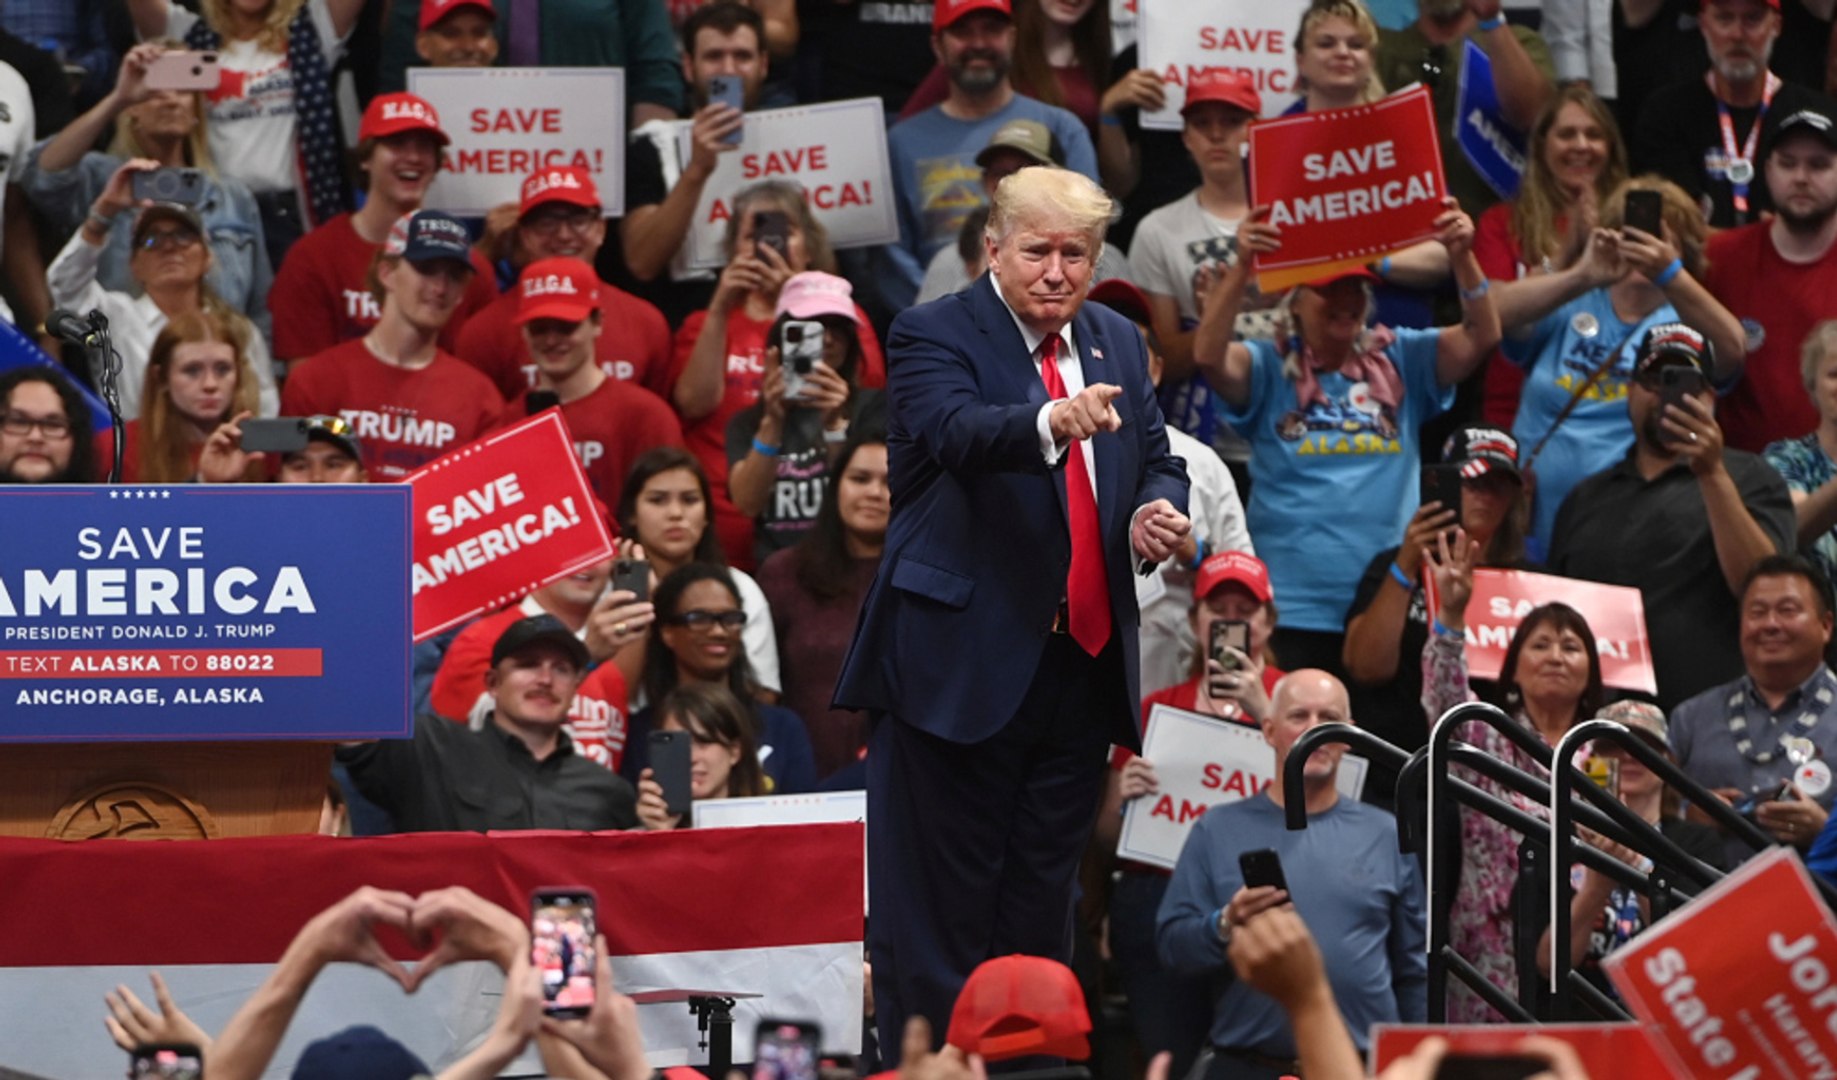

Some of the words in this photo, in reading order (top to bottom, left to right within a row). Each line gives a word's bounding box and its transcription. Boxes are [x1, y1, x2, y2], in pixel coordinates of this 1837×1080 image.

[1199, 27, 1285, 54] SAVE
[470, 108, 562, 133] SAVE
[742, 145, 828, 179] SAVE
[1303, 141, 1397, 181] SAVE
[1268, 171, 1436, 226] AMERICA!
[338, 409, 456, 449] TRUMP
[1296, 433, 1402, 455] ALASKA
[426, 472, 526, 536] SAVE
[77, 526, 205, 560] SAVE
[412, 496, 580, 596] AMERICA!
[5, 626, 104, 640] PRESIDENT
[111, 626, 188, 639] DONALD
[195, 625, 208, 639] J.
[215, 624, 276, 638] TRUMP
[6, 656, 62, 672] TEXT
[70, 655, 161, 672] ALASKA
[169, 655, 199, 671] TO
[206, 655, 275, 671] 88022
[16, 688, 166, 707] ANCHORAGE,
[173, 688, 264, 705] ALASKA
[1643, 946, 1737, 1068] State
